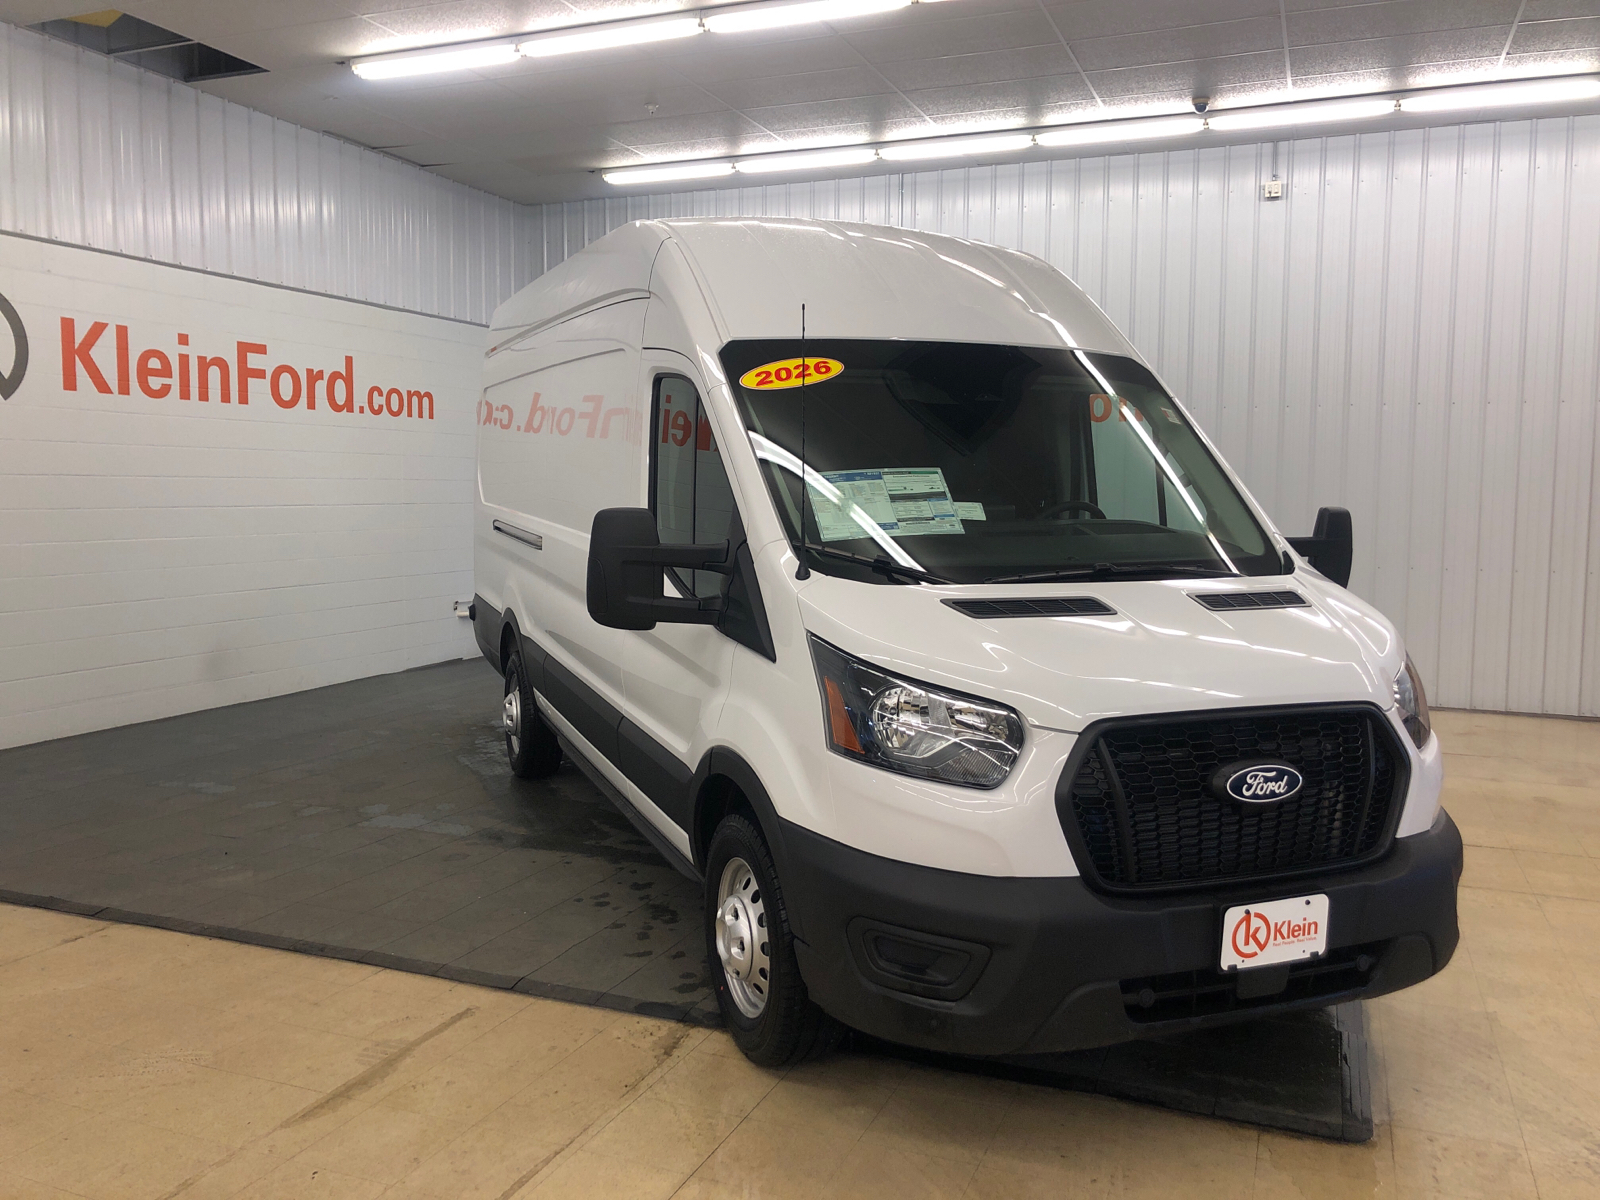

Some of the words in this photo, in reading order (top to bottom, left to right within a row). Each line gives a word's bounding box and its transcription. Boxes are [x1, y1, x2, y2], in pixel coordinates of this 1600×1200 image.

[60, 316, 435, 420] KleinFord.com
[754, 361, 832, 386] 2026
[1242, 771, 1288, 796] Ford
[1273, 917, 1319, 942] Klein
